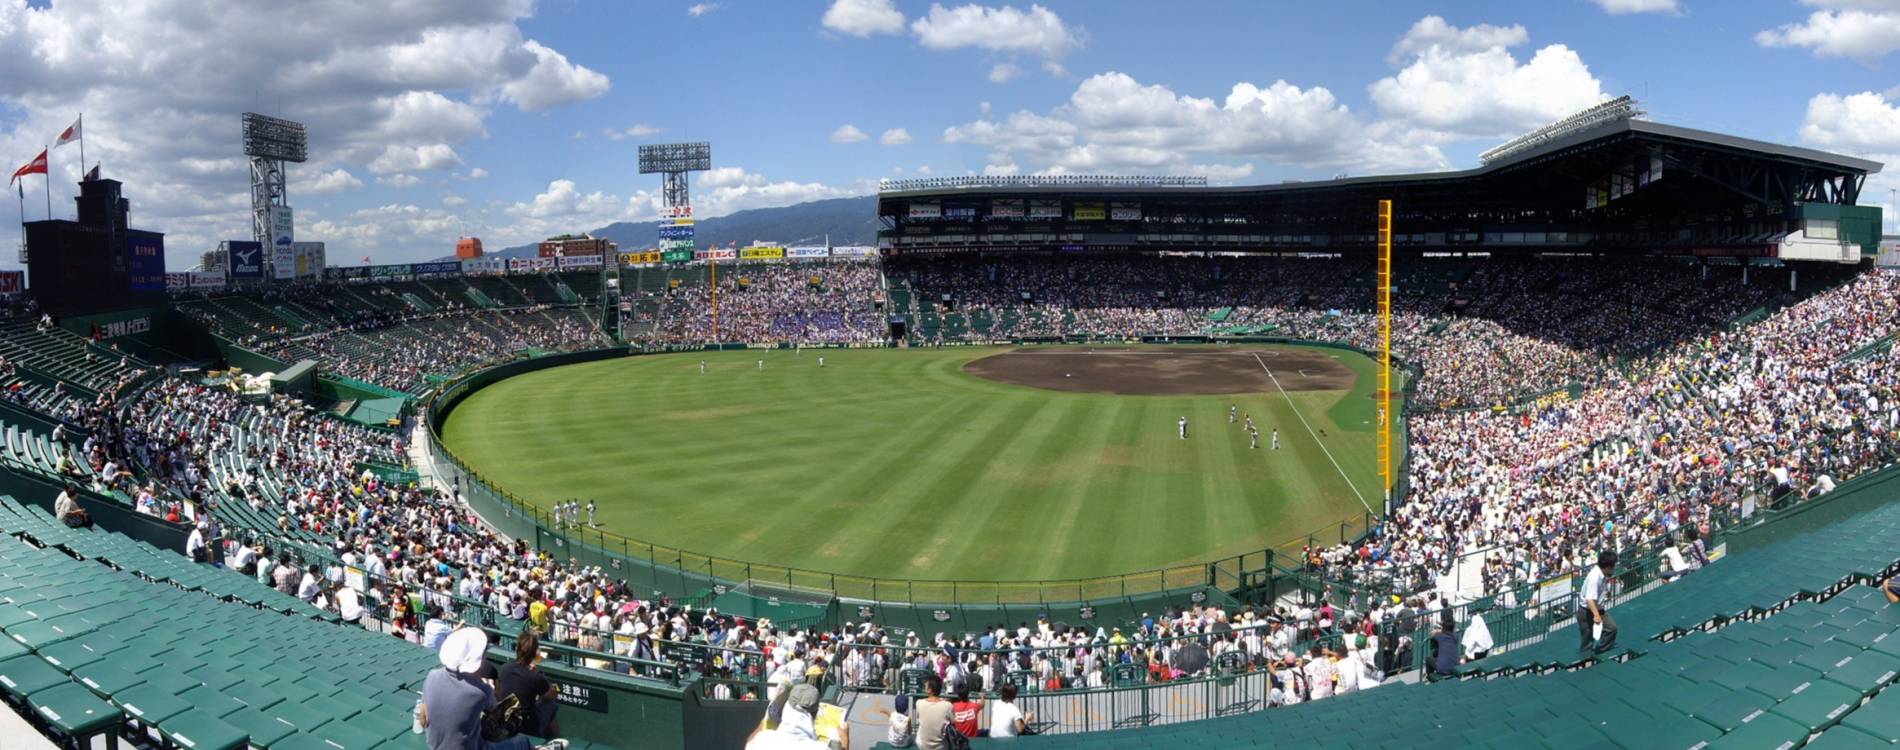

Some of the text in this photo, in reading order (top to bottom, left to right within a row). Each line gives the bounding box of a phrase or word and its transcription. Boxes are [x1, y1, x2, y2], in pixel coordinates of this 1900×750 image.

[511, 257, 553, 268] カニトップ
